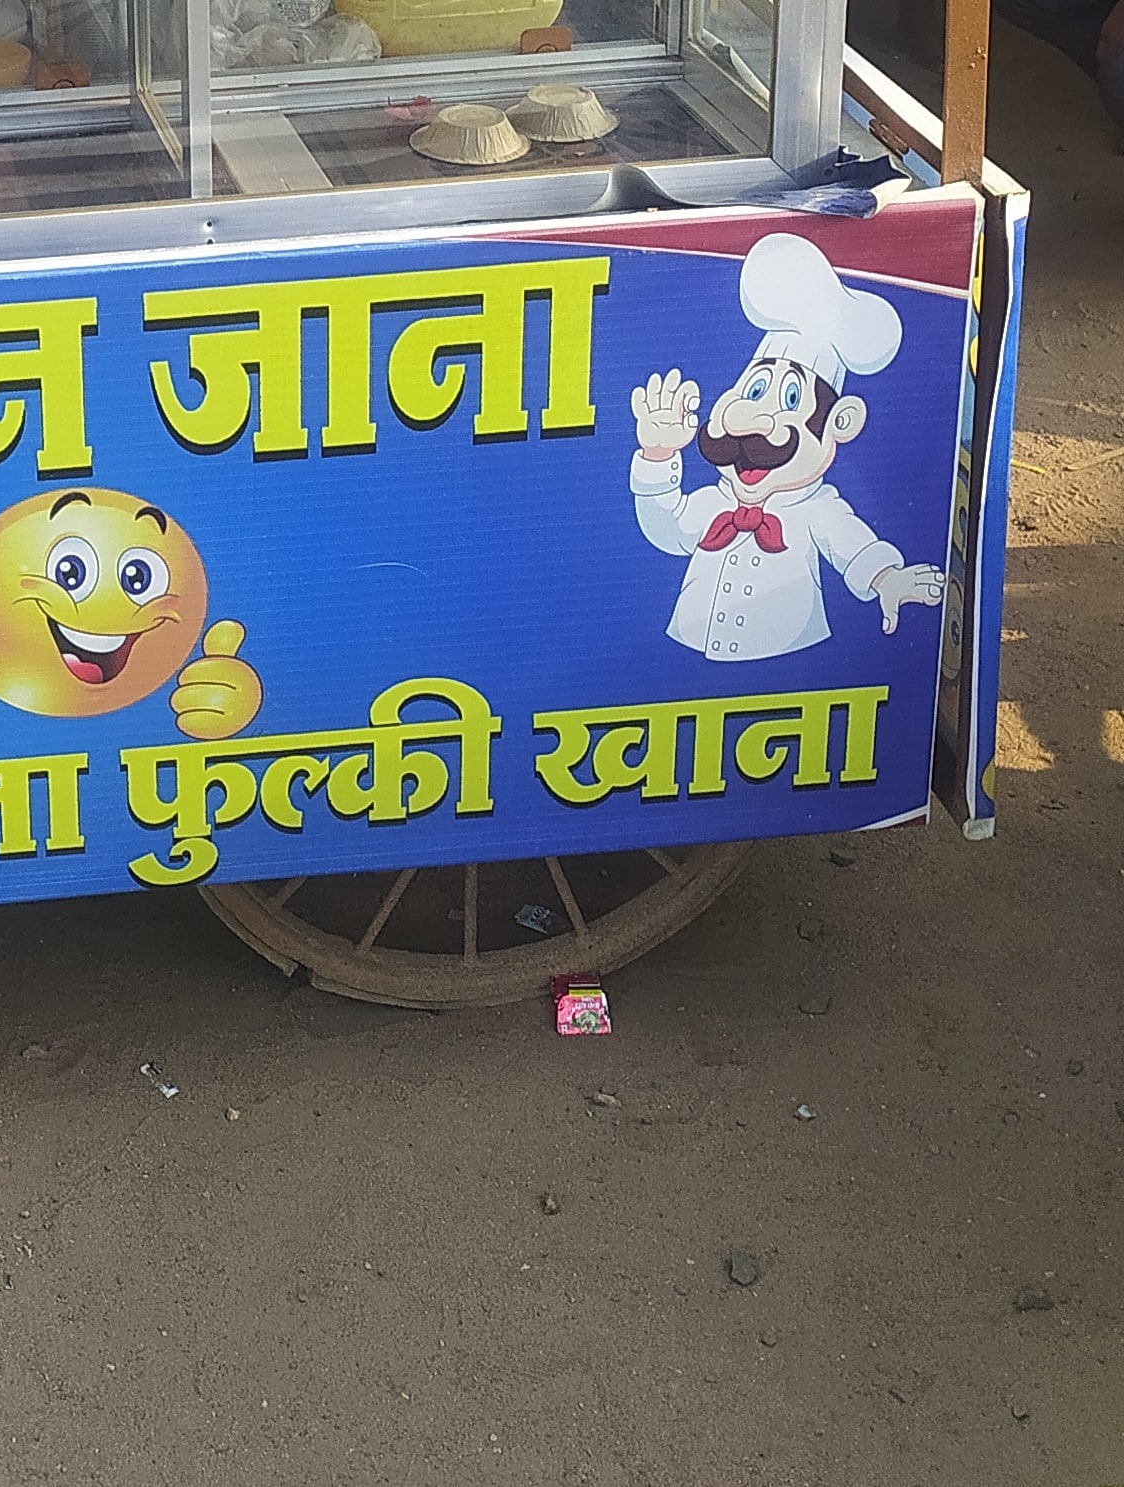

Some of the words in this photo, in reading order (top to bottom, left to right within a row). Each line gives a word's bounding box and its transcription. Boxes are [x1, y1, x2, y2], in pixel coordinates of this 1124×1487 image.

[143, 256, 611, 461] जाना
[120, 677, 502, 889] फुल्की
[533, 684, 891, 806] खाना
